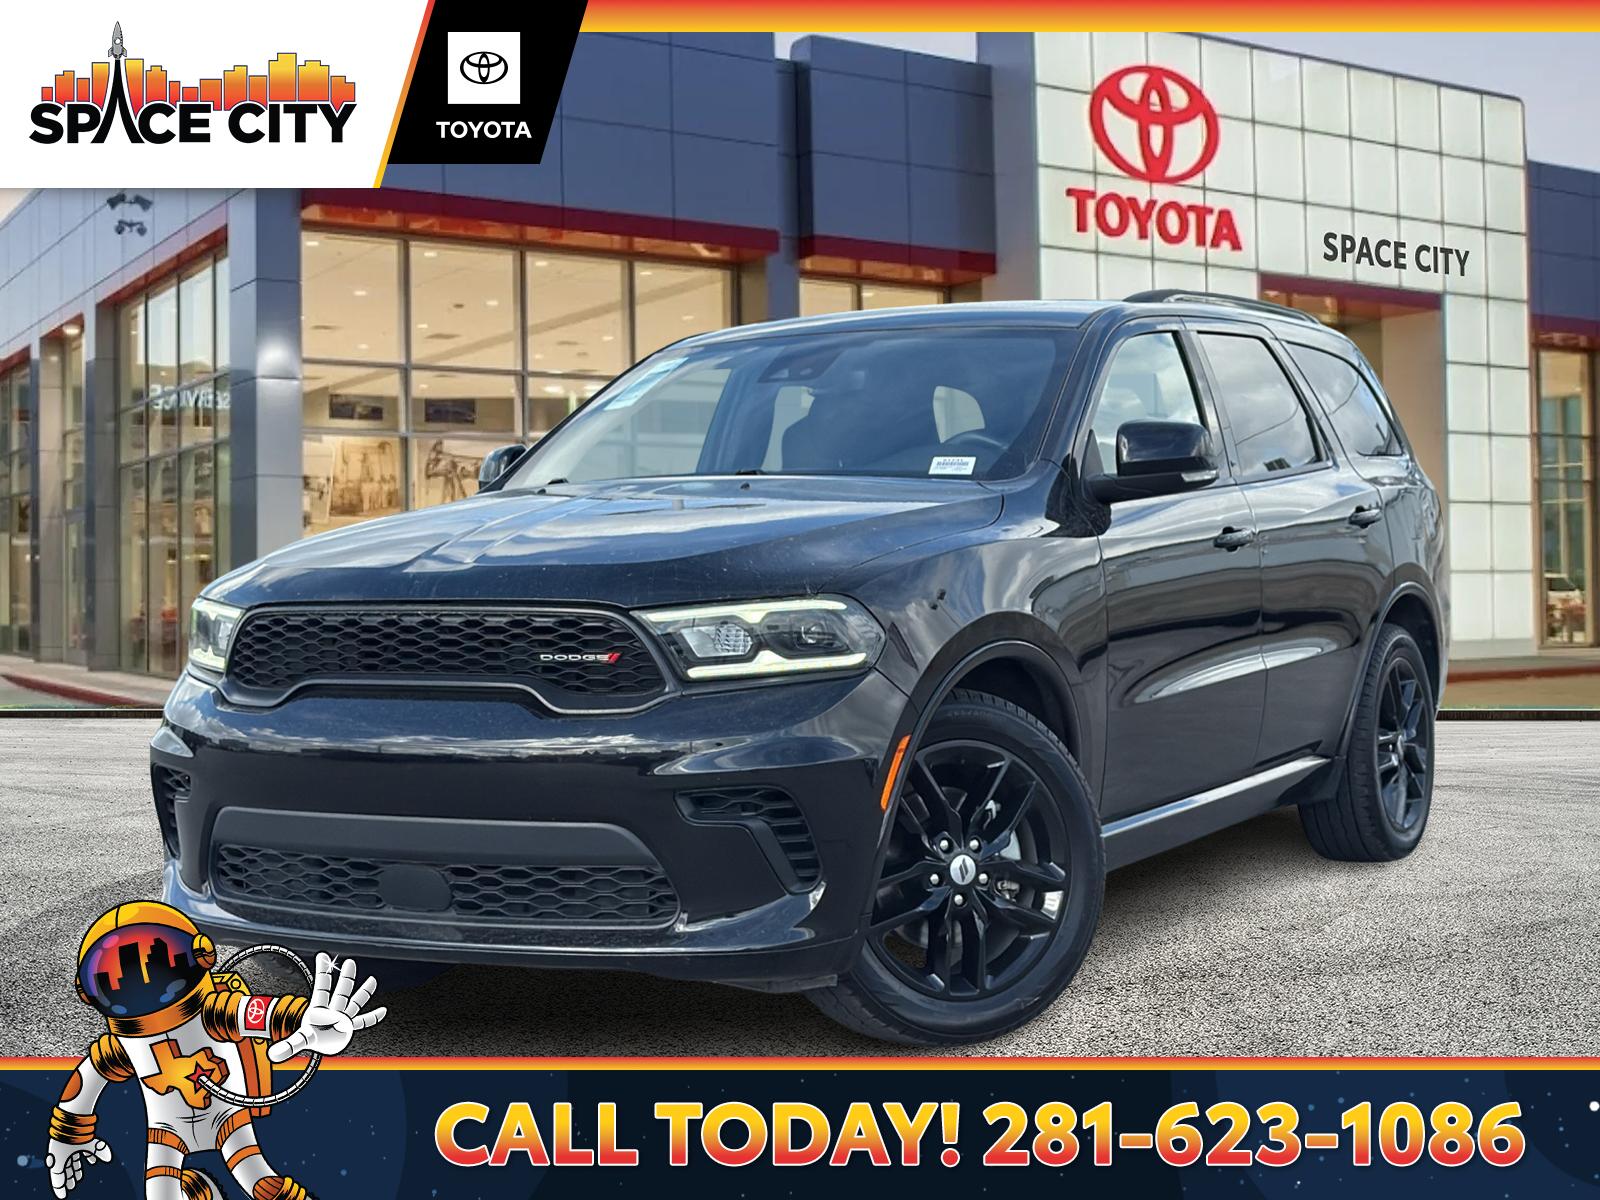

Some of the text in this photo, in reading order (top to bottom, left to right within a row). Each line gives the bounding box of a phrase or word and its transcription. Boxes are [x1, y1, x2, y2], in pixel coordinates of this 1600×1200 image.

[1066, 187, 1243, 251] TOYOTA
[1323, 231, 1471, 277] SPACE CITY
